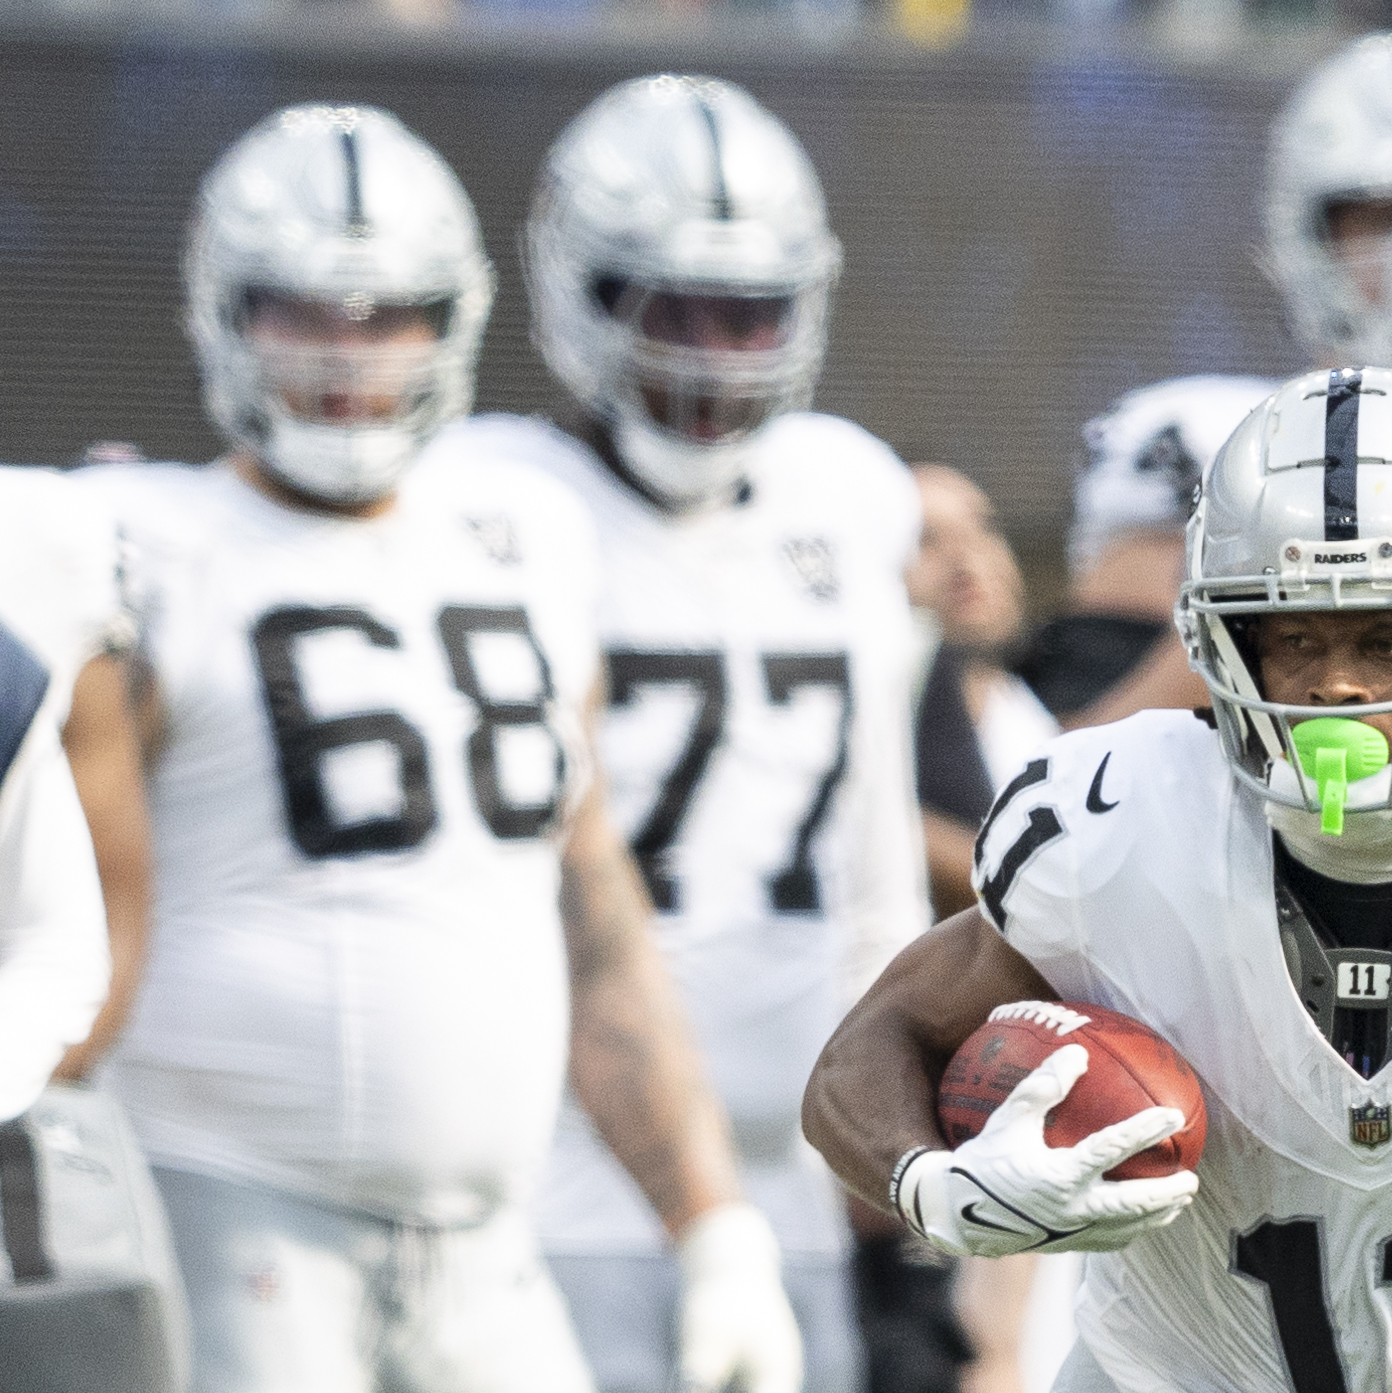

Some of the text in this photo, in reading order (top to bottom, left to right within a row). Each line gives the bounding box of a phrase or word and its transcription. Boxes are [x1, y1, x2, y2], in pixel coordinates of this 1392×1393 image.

[1314, 552, 1367, 564] RAIDERS
[251, 602, 567, 860] 68
[602, 647, 852, 916] 77
[1349, 964, 1377, 996] 11
[1355, 1120, 1389, 1142] NFL
